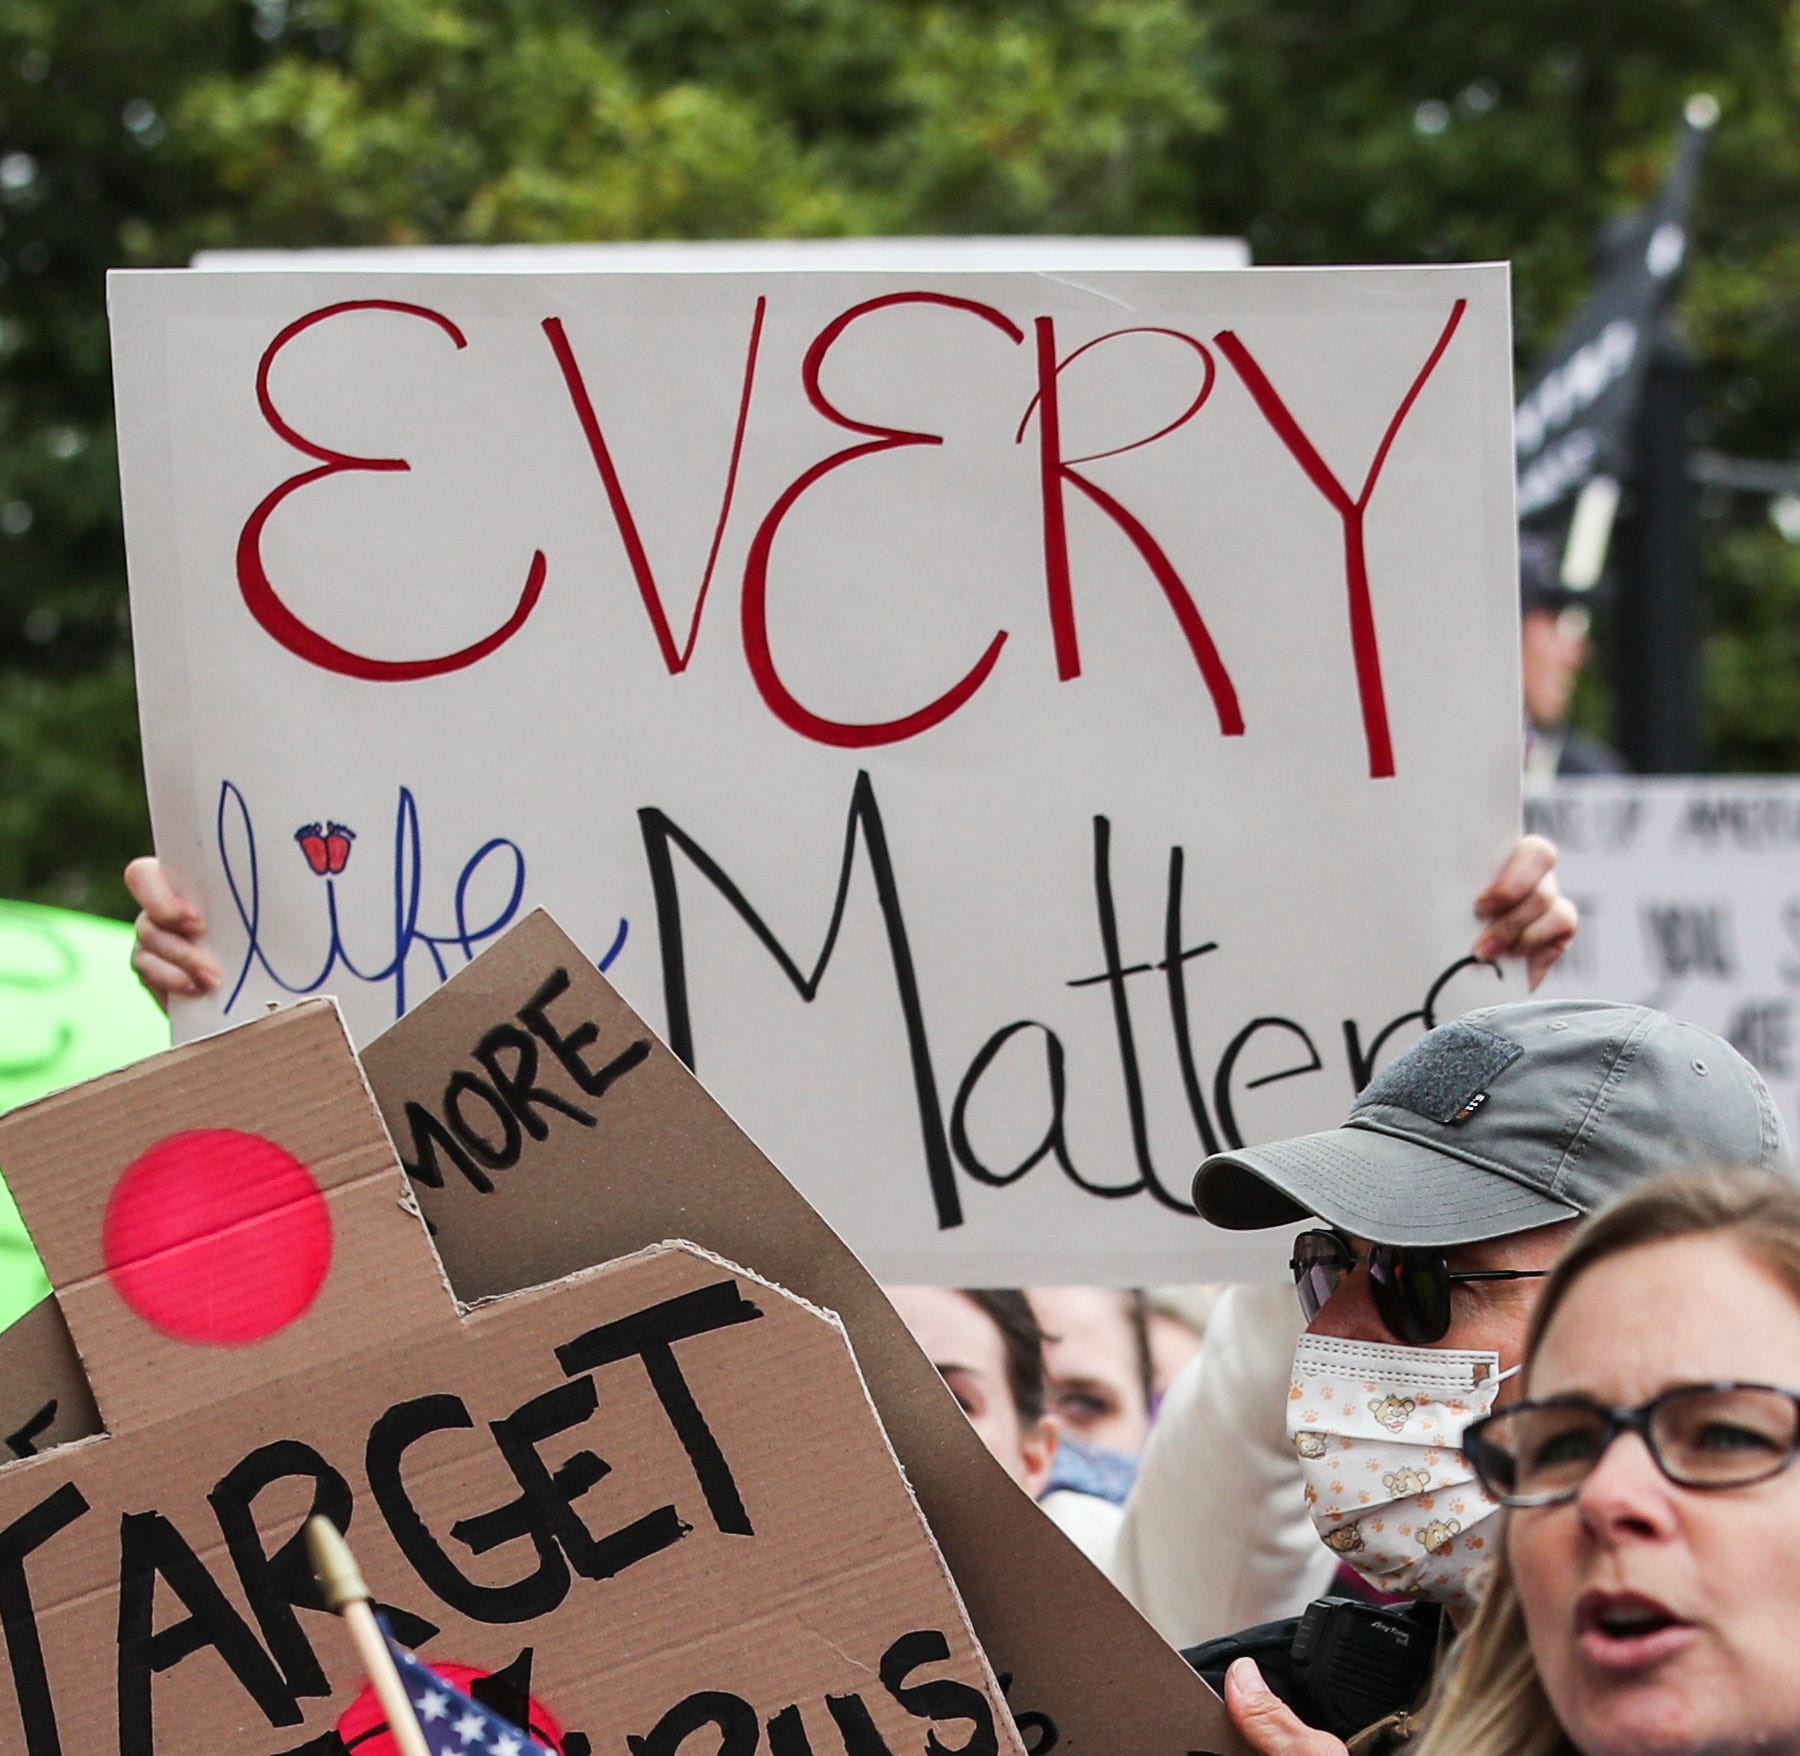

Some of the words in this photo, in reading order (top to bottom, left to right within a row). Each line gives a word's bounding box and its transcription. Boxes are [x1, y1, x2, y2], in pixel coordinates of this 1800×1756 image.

[235, 290, 1467, 780] EVERY
[217, 780, 630, 1020] life
[401, 966, 652, 1194] MORE
